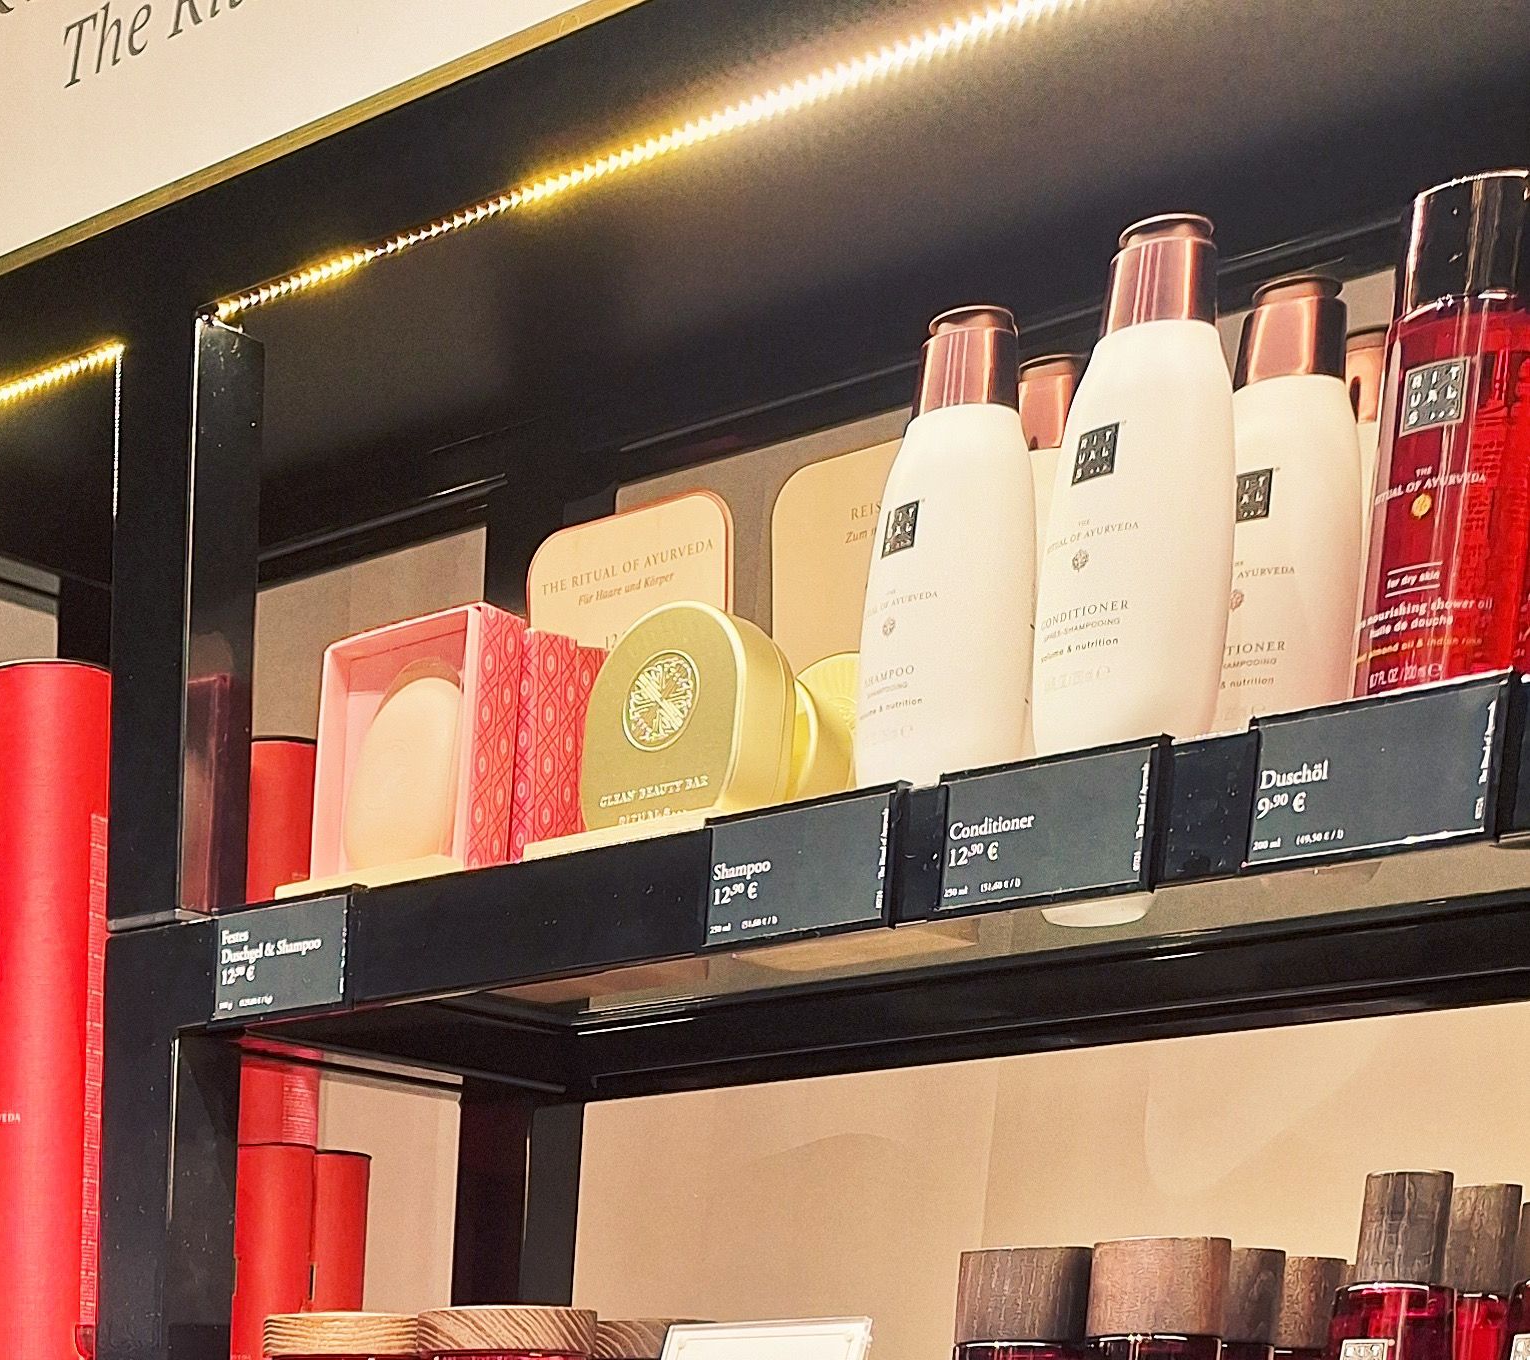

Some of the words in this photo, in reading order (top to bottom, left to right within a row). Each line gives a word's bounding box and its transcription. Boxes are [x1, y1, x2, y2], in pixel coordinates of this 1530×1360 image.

[63, 2, 151, 88] The
[1406, 482, 1422, 494] OF
[1423, 471, 1487, 491] AYURVEDA
[1082, 521, 1139, 540] AYURVEDA
[542, 578, 567, 597] THE
[571, 564, 618, 589] RITUAL
[621, 558, 641, 574] OF
[644, 538, 714, 570] AYURVEDA
[578, 591, 594, 607] Für
[595, 584, 622, 602] Haare
[624, 577, 641, 593] und
[642, 570, 675, 591] Körper
[1040, 598, 1130, 629] CONDITIONER
[1074, 635, 1119, 651] nutrition
[1230, 675, 1275, 689] nutrition
[1259, 760, 1329, 789] Duschöl
[637, 778, 683, 801] BEAUTY
[1292, 791, 1307, 813] €
[949, 814, 1036, 841] Conditioner
[986, 841, 999, 861] €
[712, 860, 772, 882] Shampoo
[746, 881, 759, 900] €
[220, 942, 264, 965] Duschgel
[264, 942, 276, 958] &
[276, 937, 323, 957] Shampoo
[246, 964, 256, 982] €
